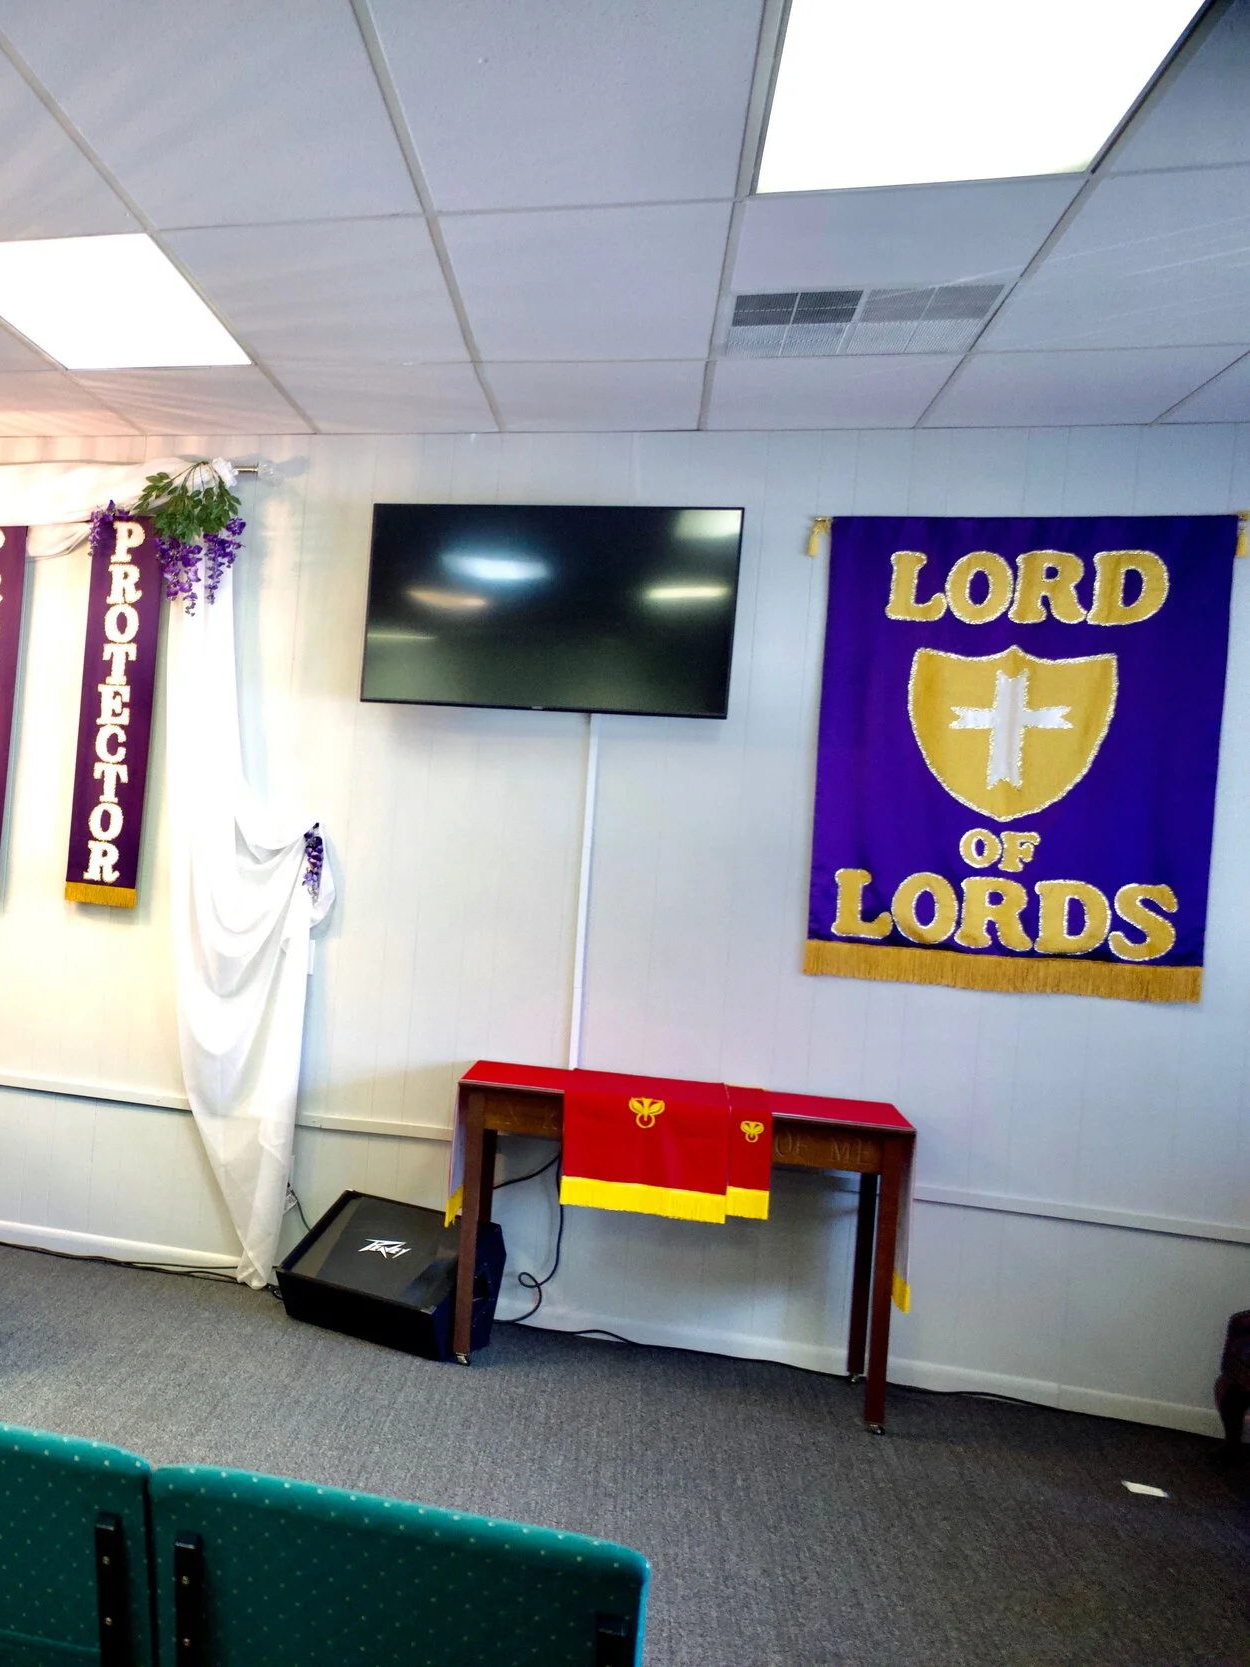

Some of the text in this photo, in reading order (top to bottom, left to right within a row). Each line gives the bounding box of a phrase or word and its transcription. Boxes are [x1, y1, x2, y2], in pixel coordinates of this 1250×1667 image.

[884, 549, 1170, 626] LORD
[83, 520, 146, 883] PROTECTOR
[958, 827, 1041, 873] OF
[831, 868, 1179, 962] LORDS
[358, 1238, 412, 1259] PEAVEY
